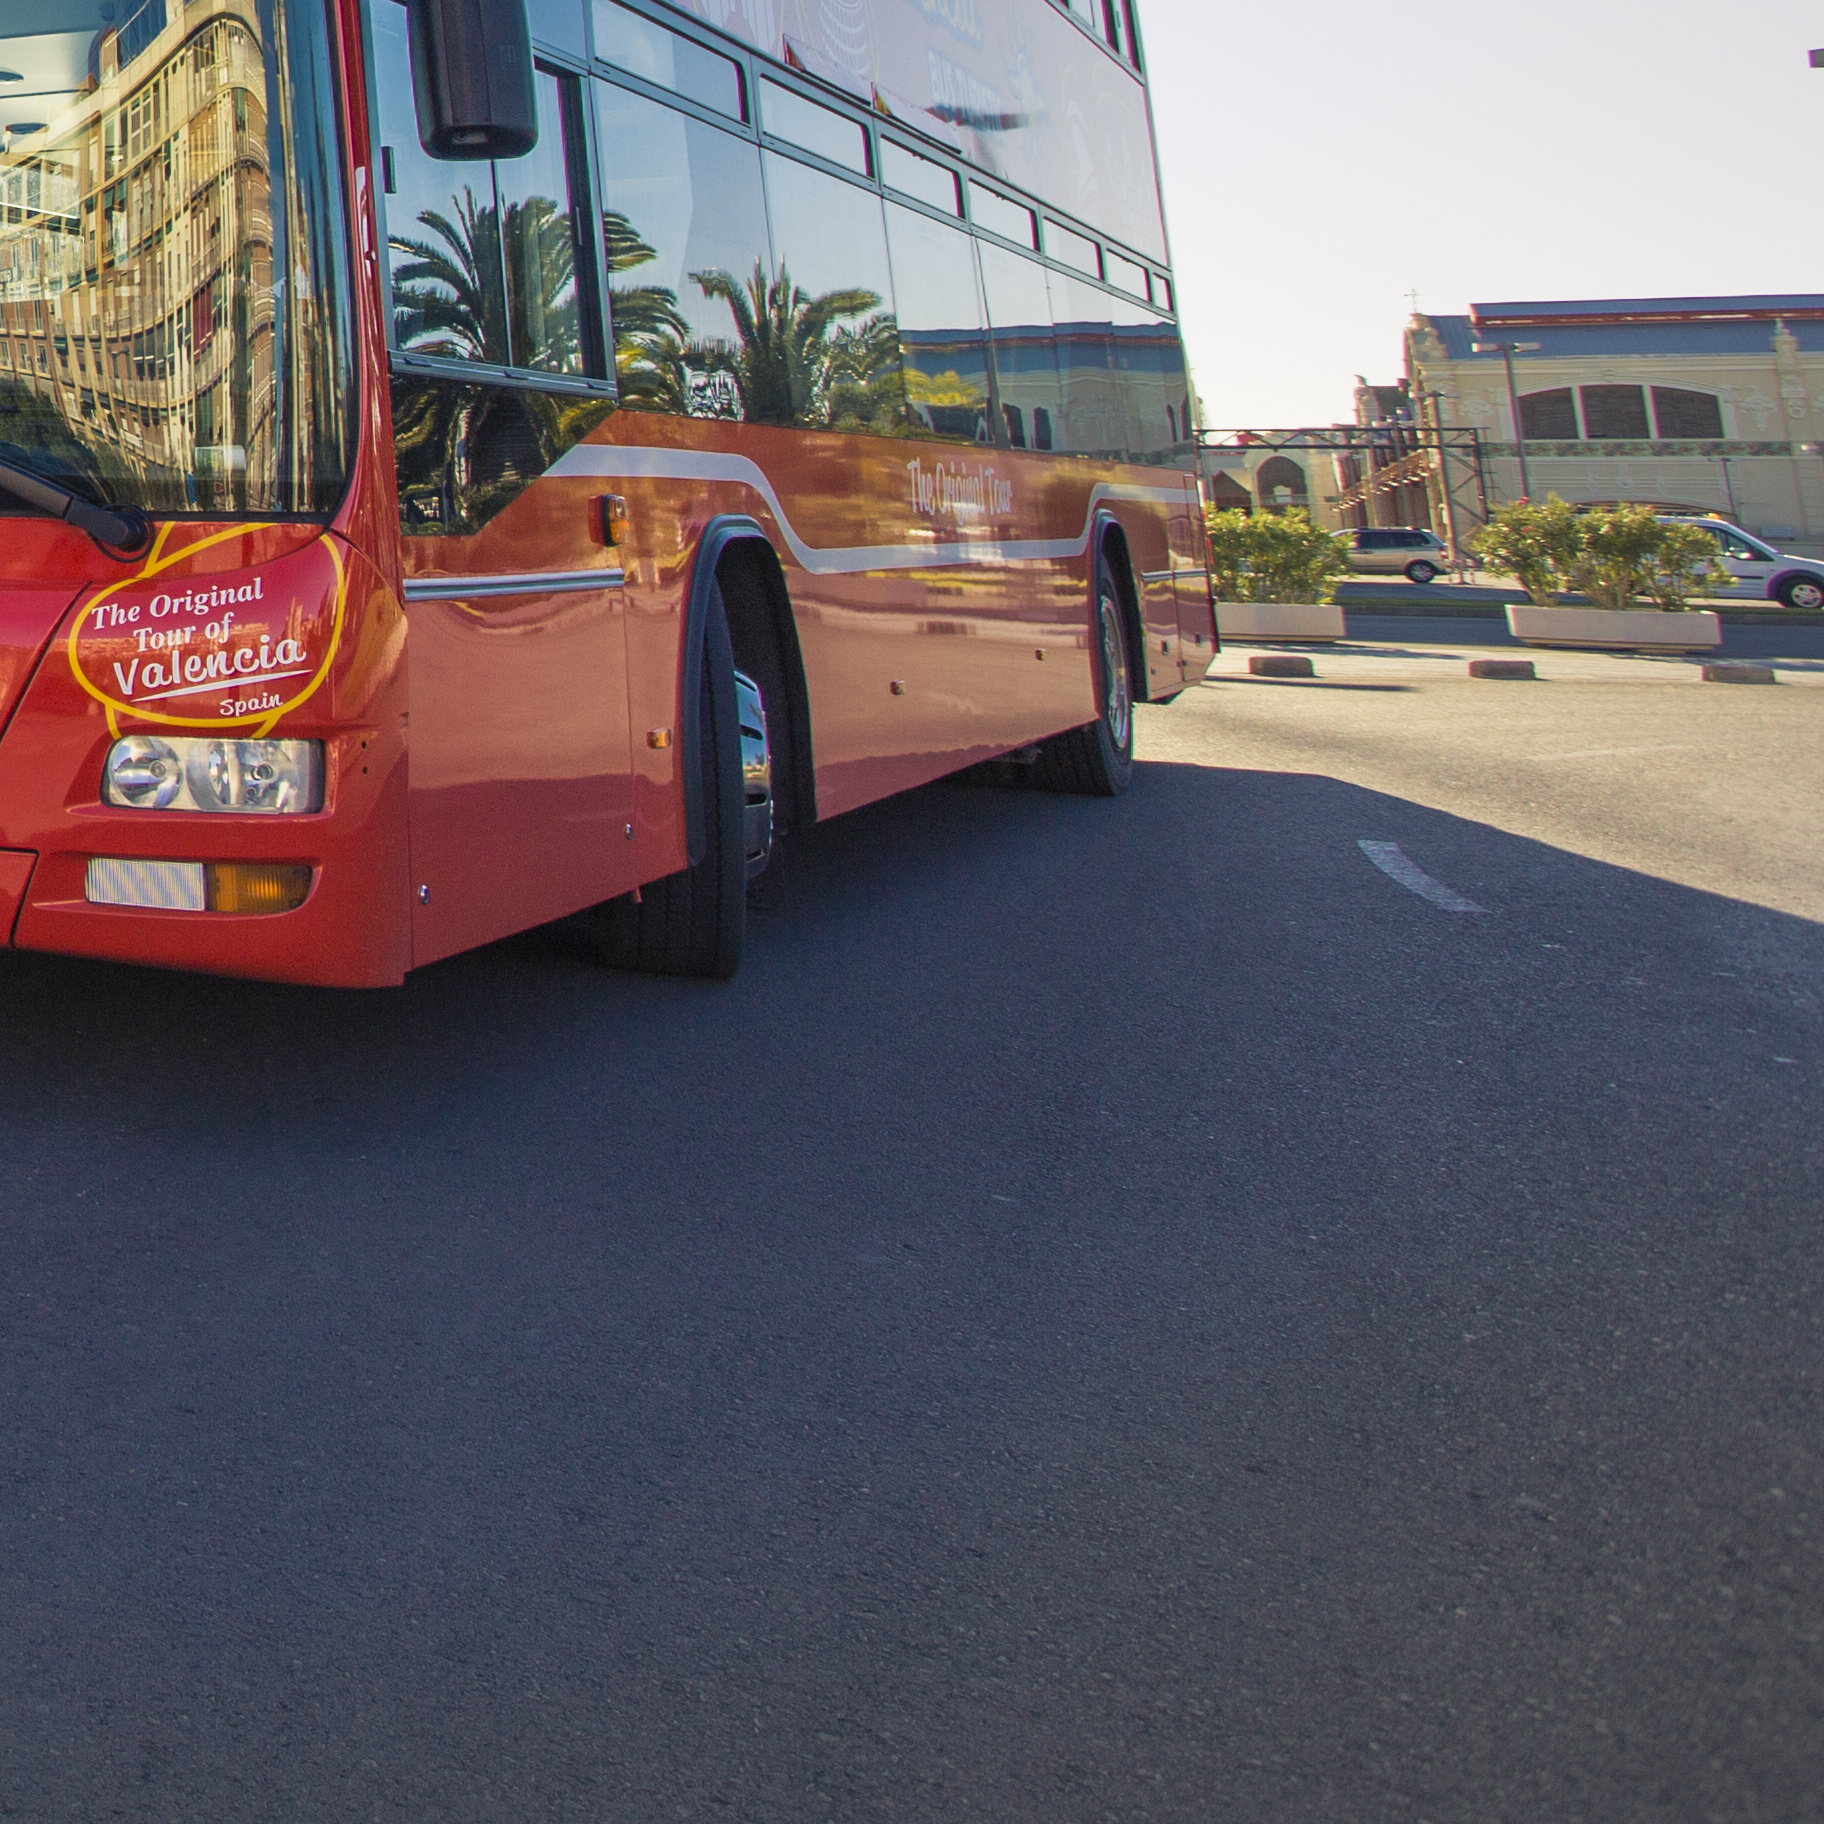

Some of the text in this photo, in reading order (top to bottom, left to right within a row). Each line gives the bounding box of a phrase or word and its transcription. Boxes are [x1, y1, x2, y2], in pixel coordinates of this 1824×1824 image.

[906, 457, 1012, 526] The Original Tour
[91, 577, 264, 631] The Original
[133, 612, 235, 653] Tour of
[113, 634, 307, 696] Valencia
[219, 692, 284, 717] Spain
